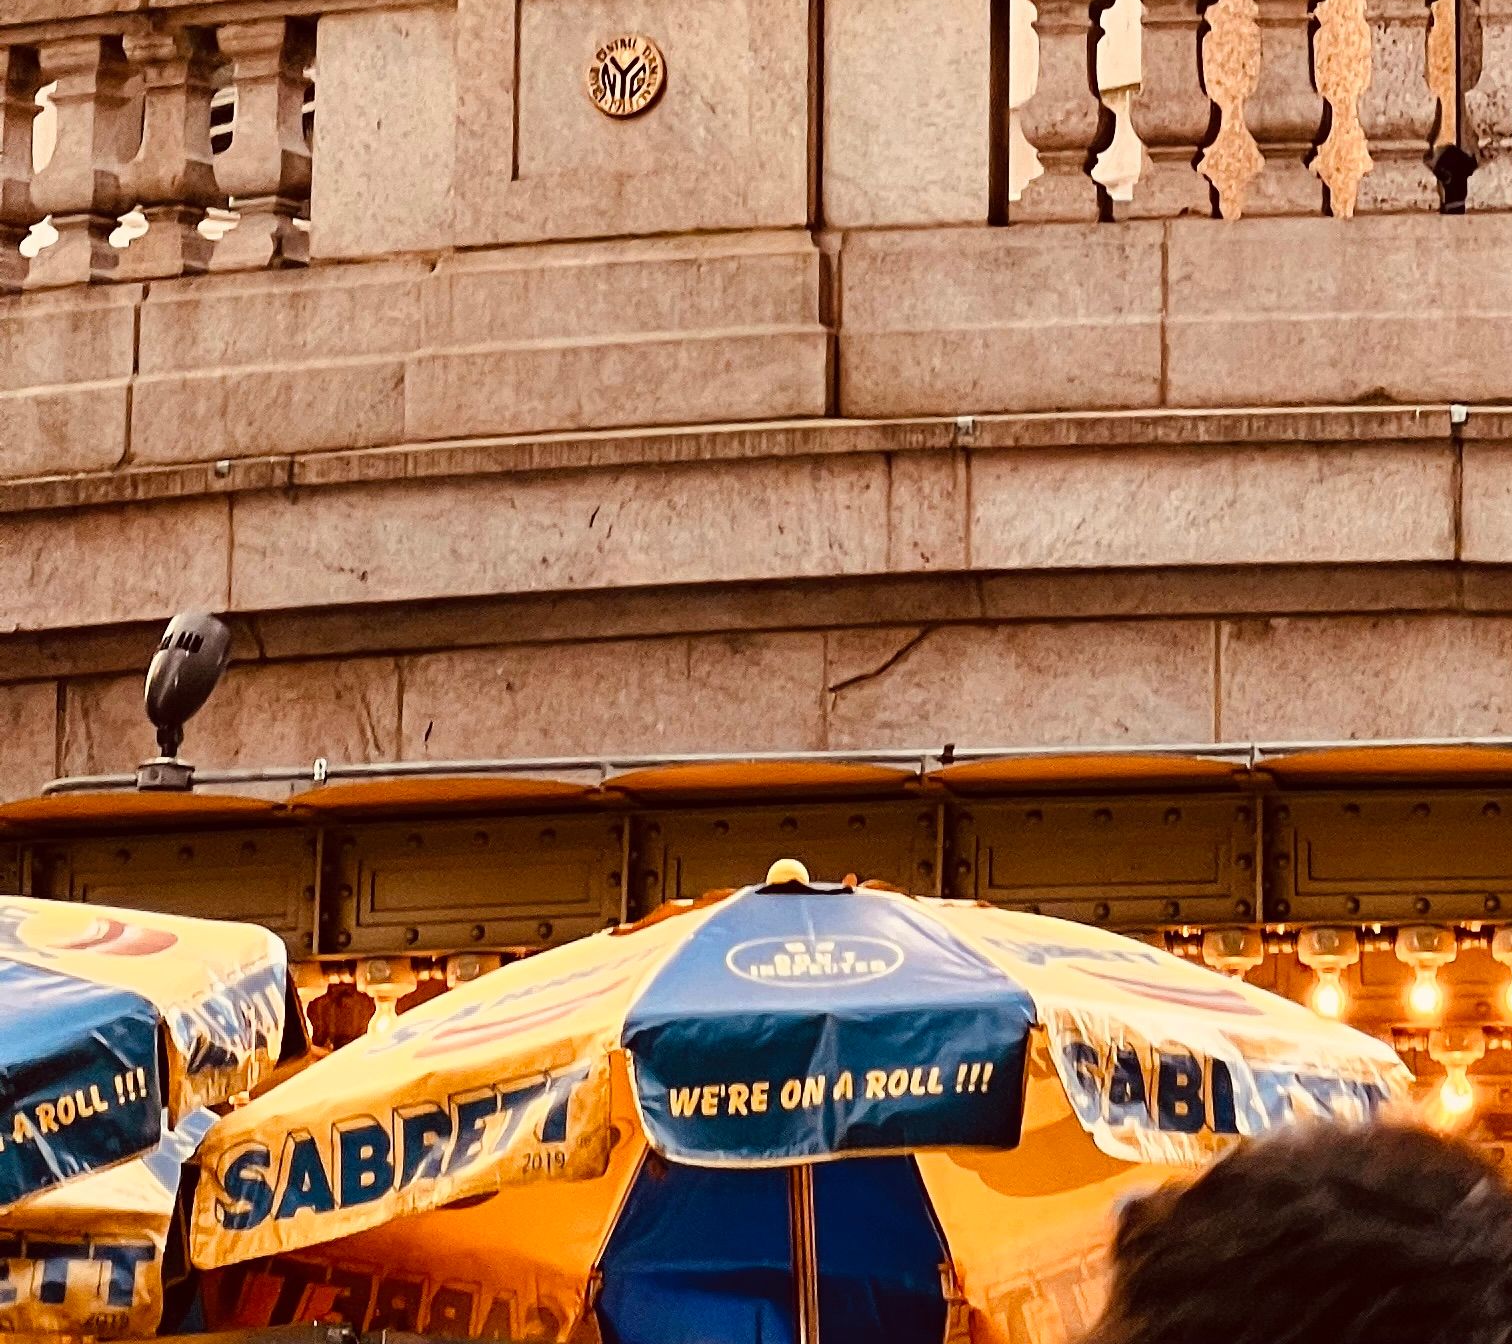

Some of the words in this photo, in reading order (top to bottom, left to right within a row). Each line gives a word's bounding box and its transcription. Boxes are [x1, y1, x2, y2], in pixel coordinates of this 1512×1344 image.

[12, 1111, 34, 1144] A
[35, 1084, 109, 1134] ROLL
[113, 1066, 147, 1105] !!!
[669, 1082, 770, 1118] WE'RE
[780, 1075, 826, 1110] ON
[833, 1072, 854, 1101] A
[865, 1066, 944, 1100] ROLL
[955, 1062, 994, 1094] !!!
[522, 1151, 566, 1176] 2019
